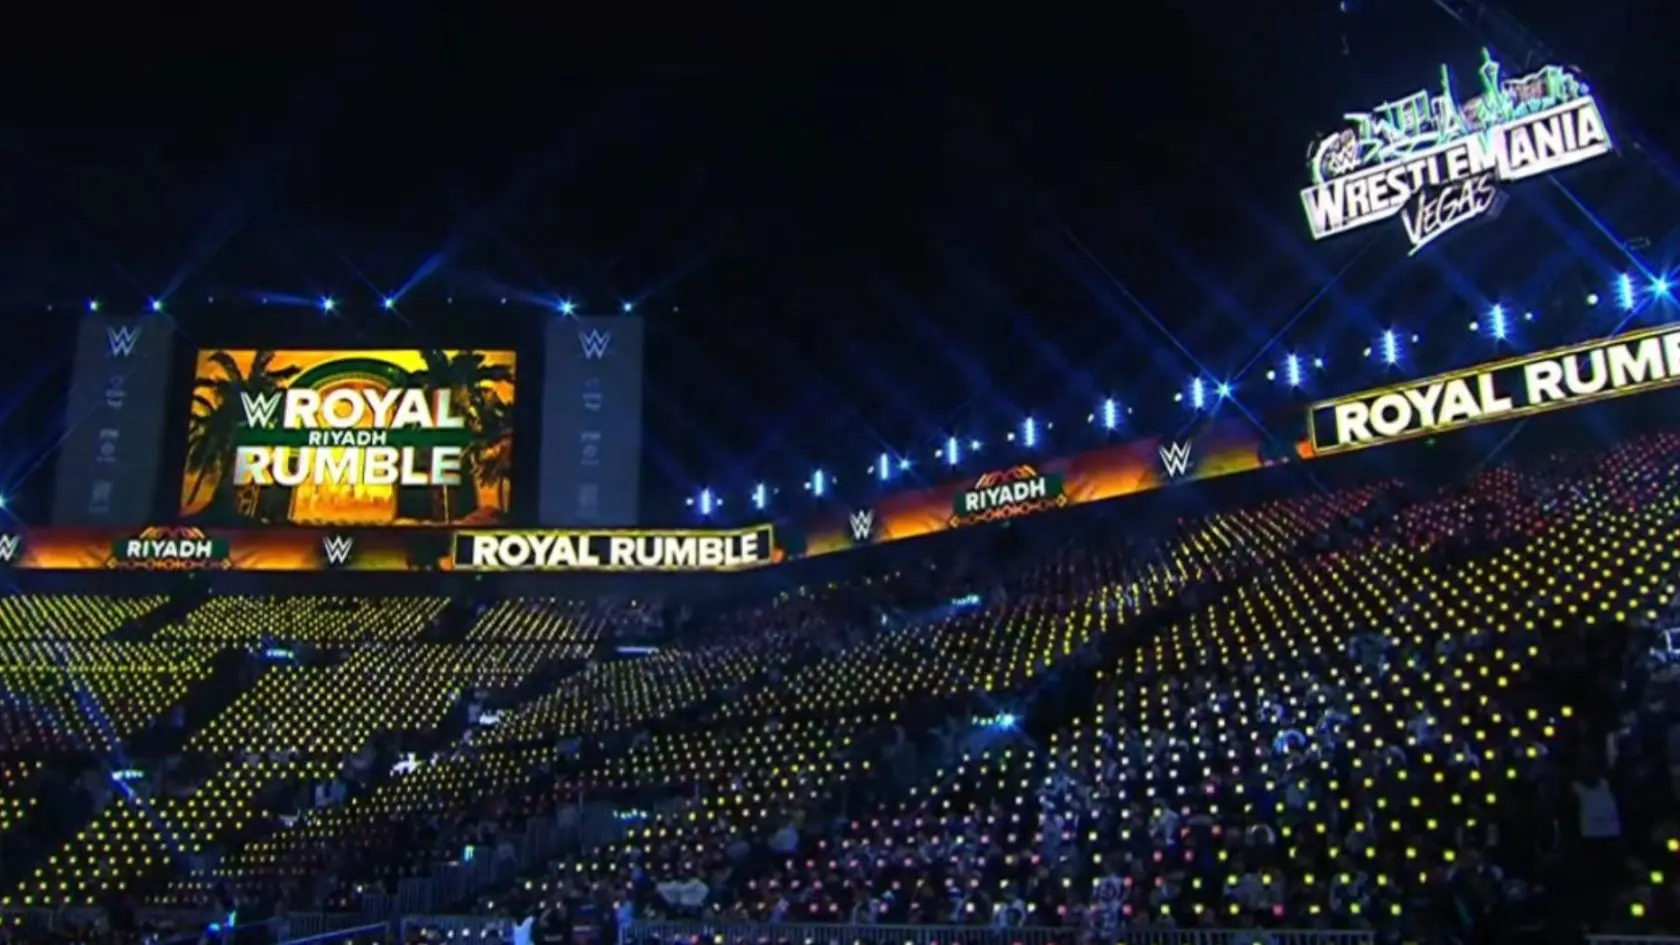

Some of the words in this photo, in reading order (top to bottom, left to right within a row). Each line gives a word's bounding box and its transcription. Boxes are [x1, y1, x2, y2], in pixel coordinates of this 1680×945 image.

[1304, 105, 1605, 235] WRESTLEMANIA
[1401, 174, 1496, 246] VEGAS
[283, 388, 465, 429] ROYAL
[1335, 374, 1512, 445] ROYAL
[308, 430, 387, 446] RIYADH
[233, 446, 462, 486] RUMBLE
[965, 477, 1046, 512] RIYADH
[126, 539, 213, 559] RIYADH
[472, 535, 599, 567] ROYAL
[609, 533, 759, 567] RUMBLE
